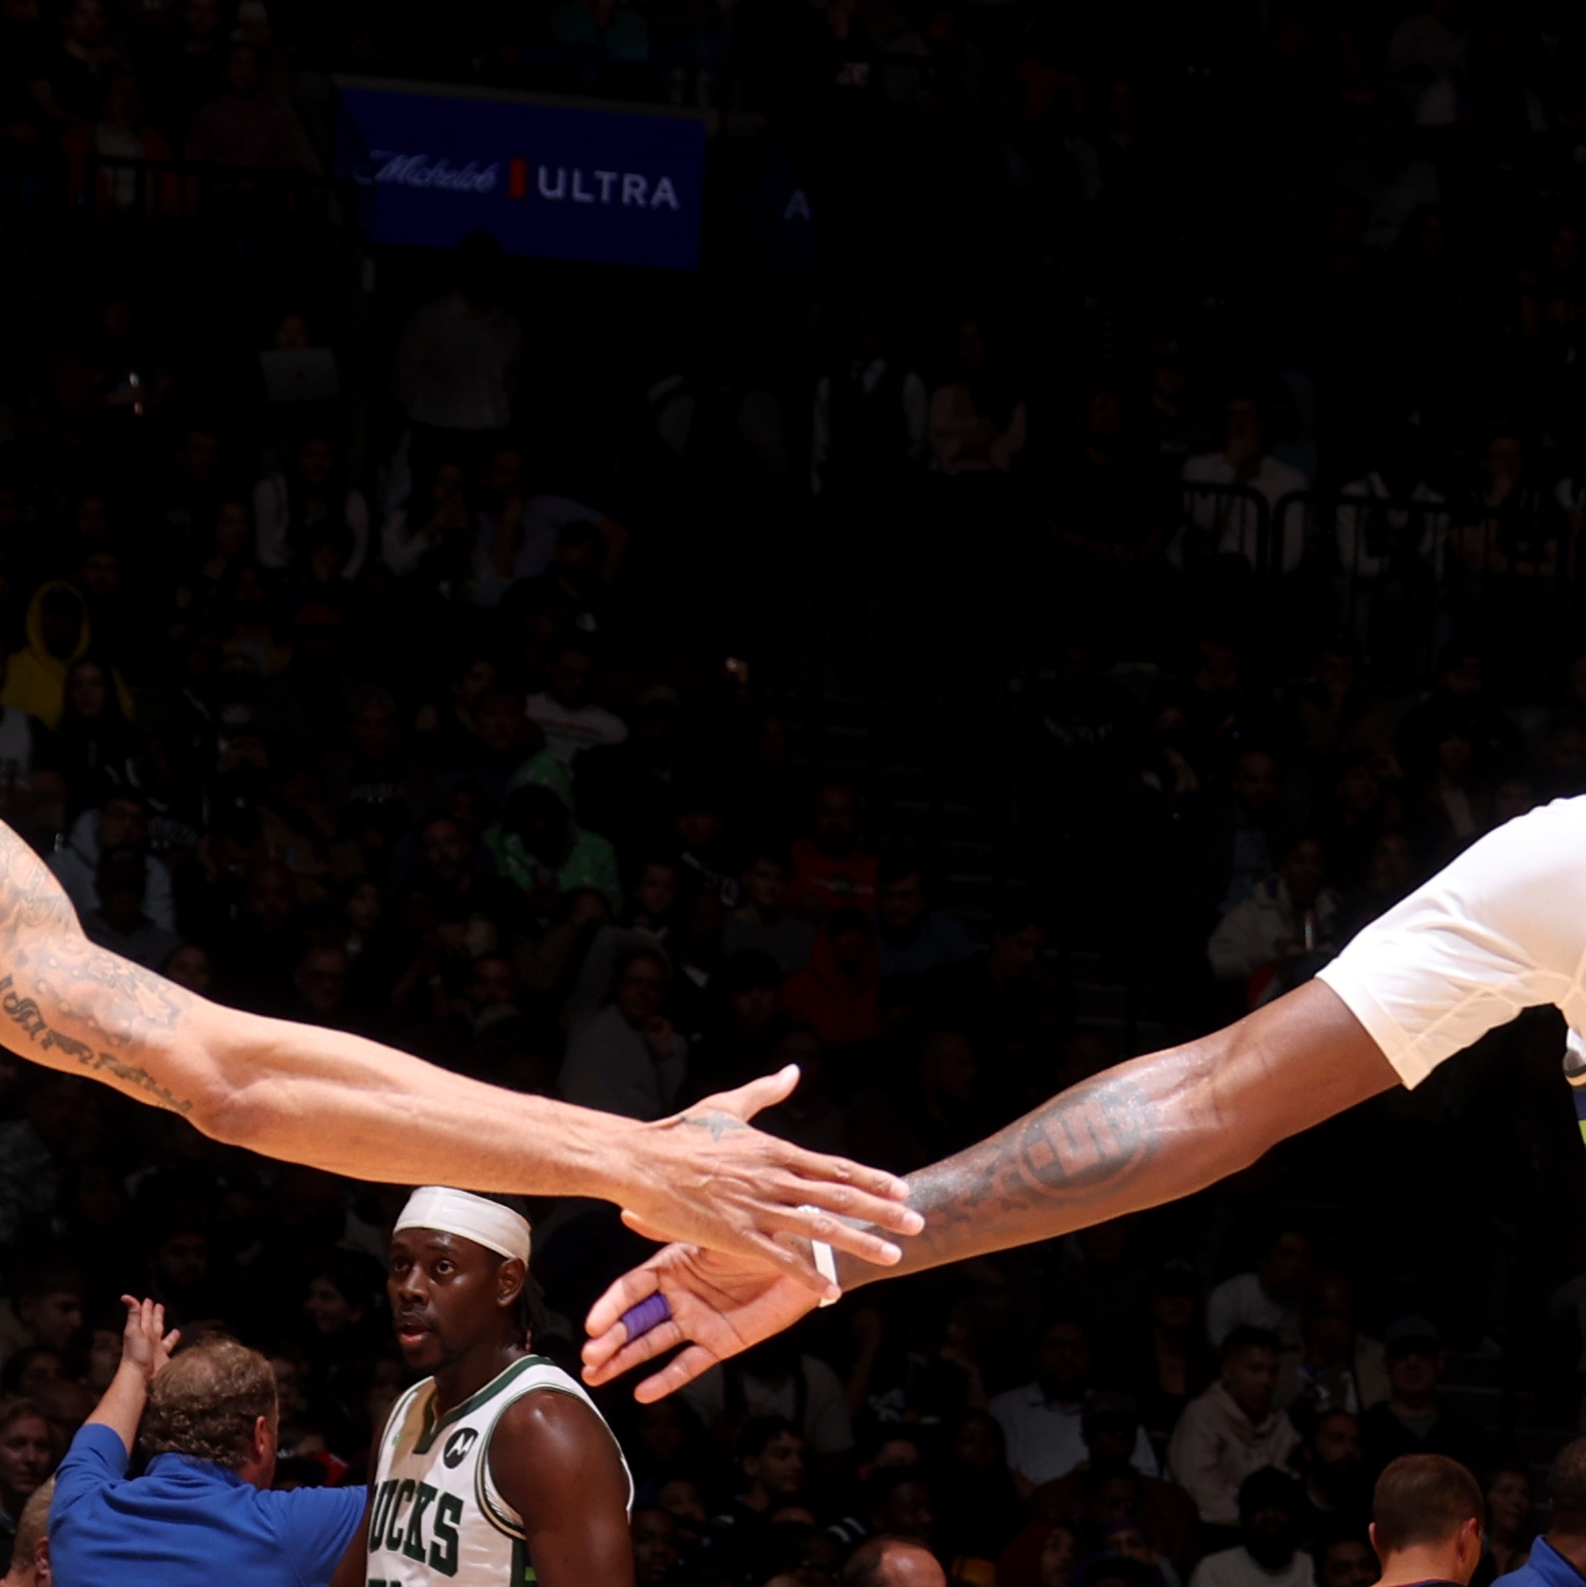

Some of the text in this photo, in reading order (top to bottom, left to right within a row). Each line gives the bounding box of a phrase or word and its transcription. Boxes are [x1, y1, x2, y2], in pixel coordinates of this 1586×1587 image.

[353, 150, 682, 212] Michelob ULTRA
[368, 1478, 465, 1578] UCKS
